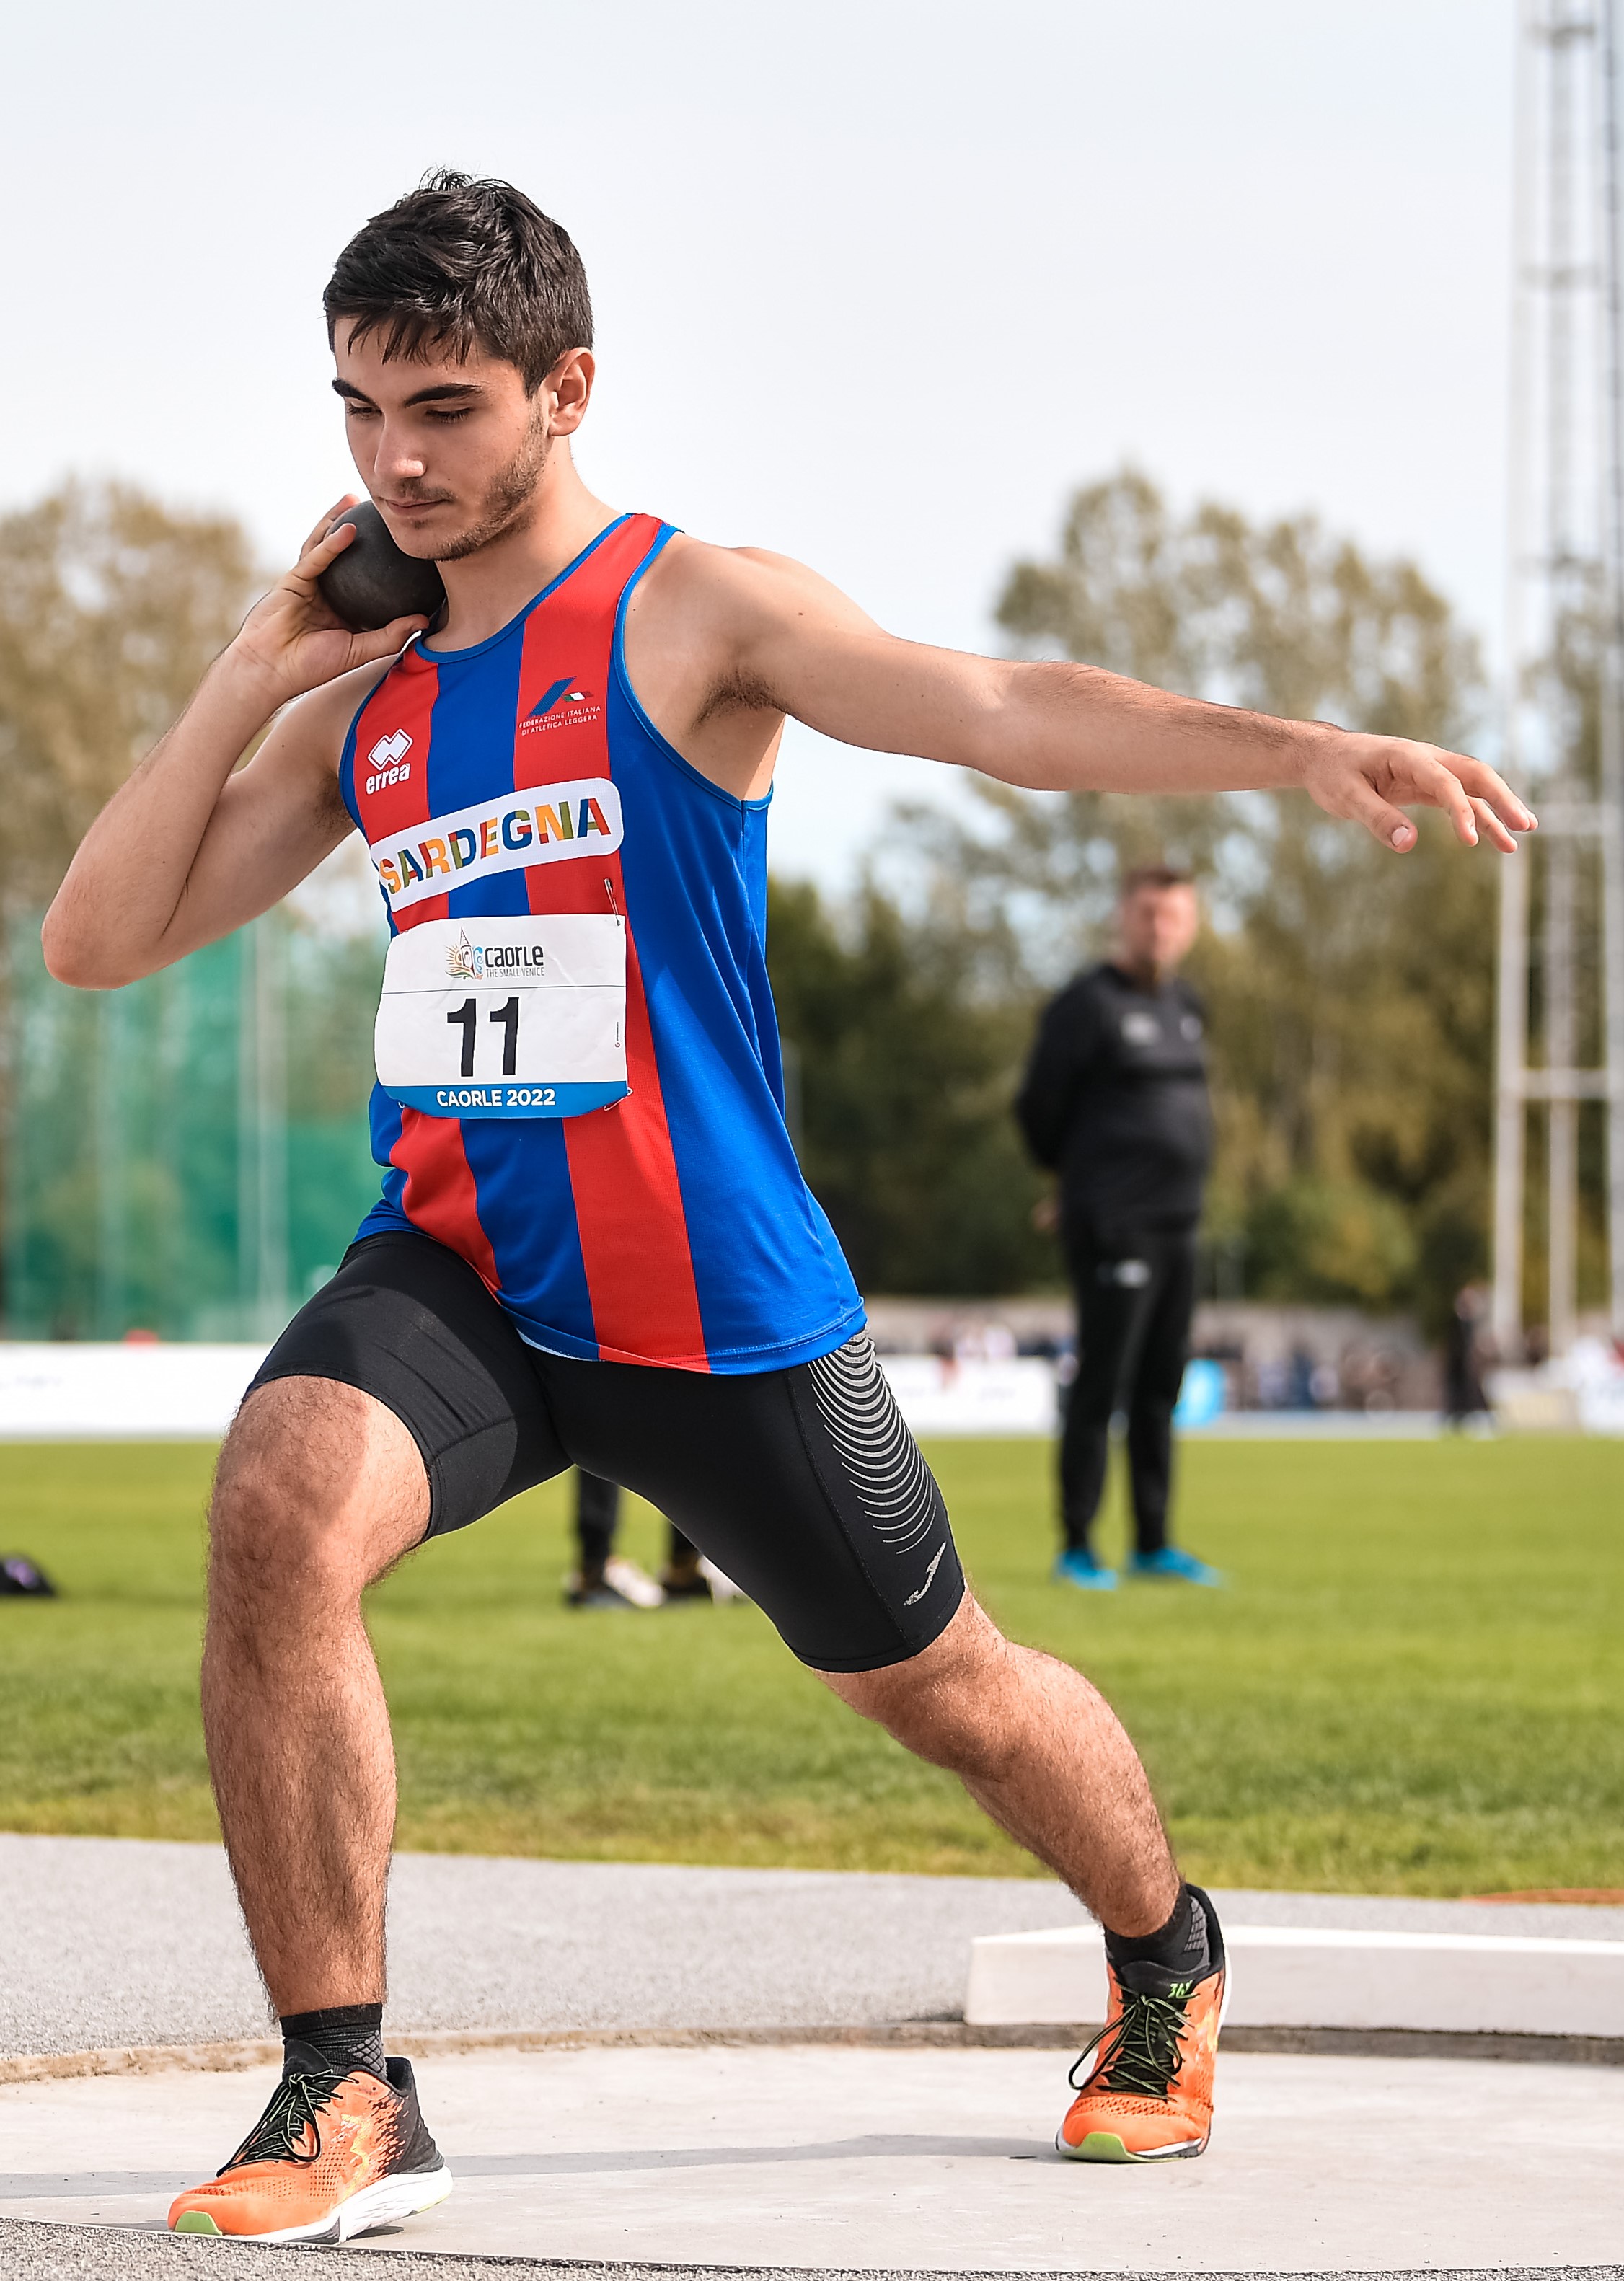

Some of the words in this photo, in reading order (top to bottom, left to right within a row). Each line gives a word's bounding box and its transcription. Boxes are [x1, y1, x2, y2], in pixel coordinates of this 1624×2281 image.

[518, 712, 565, 728] FEDERAZIONE
[567, 706, 601, 717] ITALIANA
[530, 721, 562, 733] ATLETICA
[565, 715, 597, 725] LEGGERA
[366, 762, 410, 795] errea
[379, 797, 612, 894] SARDEGNA
[486, 969, 498, 977] THE
[500, 968, 520, 977] SMALL
[521, 966, 545, 976] VENICE
[447, 997, 519, 1077] 11
[436, 1090, 503, 1107] CAORLE
[506, 1088, 556, 1106] 2022
